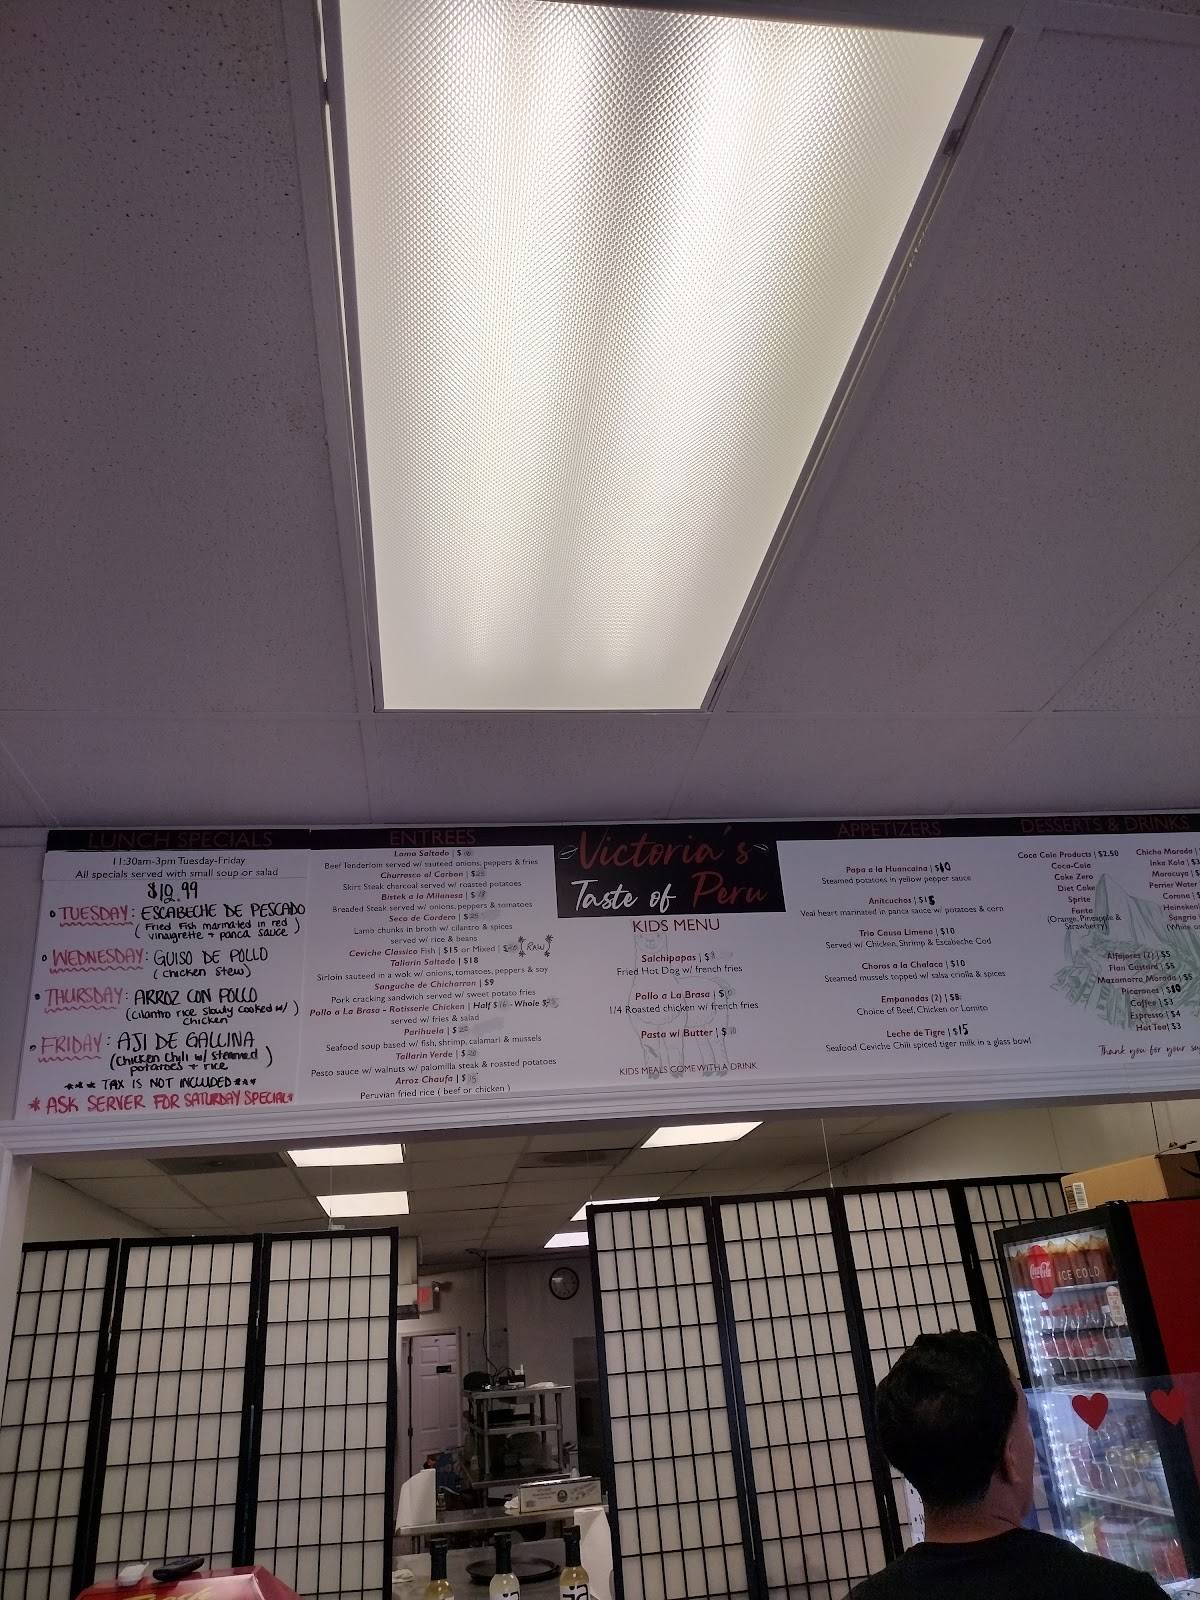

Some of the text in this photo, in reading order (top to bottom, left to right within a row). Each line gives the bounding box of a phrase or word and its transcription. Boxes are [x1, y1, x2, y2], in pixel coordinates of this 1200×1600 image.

[838, 821, 941, 838] APPETIZERS
[1021, 815, 1191, 833] DESSERTS DRINKS
[88, 831, 273, 849] LUNCH SPECIALS
[390, 829, 477, 845] ENTREES
[419, 849, 450, 857] Saltado
[1059, 849, 1119, 858] Products $2.50
[113, 856, 246, 867] 11:30am-3pm Tuesday-Friday
[75, 868, 279, 880] All specials served with small soup salad
[380, 871, 421, 879] Churrasco
[434, 870, 464, 878] Carbon
[1151, 870, 1189, 879] Maracuya
[386, 879, 522, 890] charcoal served roasted potatoes
[381, 893, 406, 901] Bistek
[571, 870, 768, 914] Taste of Peru
[1067, 896, 1091, 904] Sprite
[141, 904, 217, 920] ESCABECHE
[223, 903, 243, 918] DE
[251, 902, 306, 917] PESCADO
[332, 903, 415, 913] Breaded Steak served
[272, 918, 289, 927] red
[423, 913, 456, 921] Cordero
[377, 924, 437, 934] chunks broth
[632, 918, 720, 933] KIDS MENU
[940, 927, 955, 935] $10
[148, 928, 289, 943] vinaigrette panca sauce
[390, 936, 417, 944] served
[153, 949, 193, 967] GUISO
[202, 950, 220, 965] DE
[230, 946, 268, 963] POLLO
[348, 948, 382, 957] Ceviche
[384, 947, 418, 956] Classico
[443, 946, 459, 954] $15
[472, 945, 496, 953] Mixed
[424, 956, 479, 966] Saltado $18
[641, 953, 697, 965] Salchipapas
[617, 963, 743, 977] Fried Hot Dog french fries
[861, 960, 966, 970] Choros Chalaca $10
[394, 970, 411, 978] wok
[430, 980, 476, 988] Chicharron
[484, 979, 495, 987] $9
[1097, 976, 1144, 984] Mazamorra
[134, 989, 182, 1005] ARROZ
[187, 988, 212, 1003] CON
[219, 987, 258, 1003] POLLO
[331, 992, 452, 1004] Pork sandwich served
[635, 992, 659, 1001] Pollo
[684, 990, 711, 999] Brasa
[881, 994, 929, 1004] Empanadas
[309, 1008, 332, 1016] Pollo
[356, 1006, 380, 1015] Brasa
[389, 1004, 429, 1013] Rotisserie
[432, 1003, 465, 1012] Chicken
[473, 1001, 491, 1011] Half
[514, 998, 540, 1007] Whole
[625, 1000, 759, 1014] Roasted chicken french fries
[1130, 999, 1157, 1008] Coffee
[176, 1008, 197, 1017] rice
[856, 1004, 948, 1016] Choice Chicken
[391, 1017, 418, 1025] served
[1130, 1011, 1164, 1021] Espresso
[403, 1027, 444, 1036] Parihuela
[641, 1028, 714, 1039] Pasta Butter
[886, 1023, 969, 1038] Leche Tigre $15
[117, 1031, 147, 1052] AJI
[155, 1032, 178, 1050] DE
[185, 1031, 255, 1048] GALLINA
[326, 1040, 406, 1052] Seafood based
[826, 1044, 858, 1052] Seafood
[1097, 1044, 1186, 1059] Thank you for your
[430, 1050, 453, 1058] Verde
[130, 1062, 228, 1076] potatoes rice
[311, 1069, 334, 1077] Pesto
[490, 1059, 520, 1067] roasted
[522, 1058, 557, 1068] potatoes
[619, 1061, 758, 1076] KIDS MEALS COME DRINK
[102, 1079, 125, 1090] TAX
[150, 1077, 174, 1088] NOT
[394, 1075, 453, 1085] Arroz Chaufa
[360, 1085, 505, 1099] Peruvian fried chicken
[46, 1090, 240, 1115] ASK SERVER FOR SATURDAY
[1057, 1265, 1100, 1282] ICE COLD
